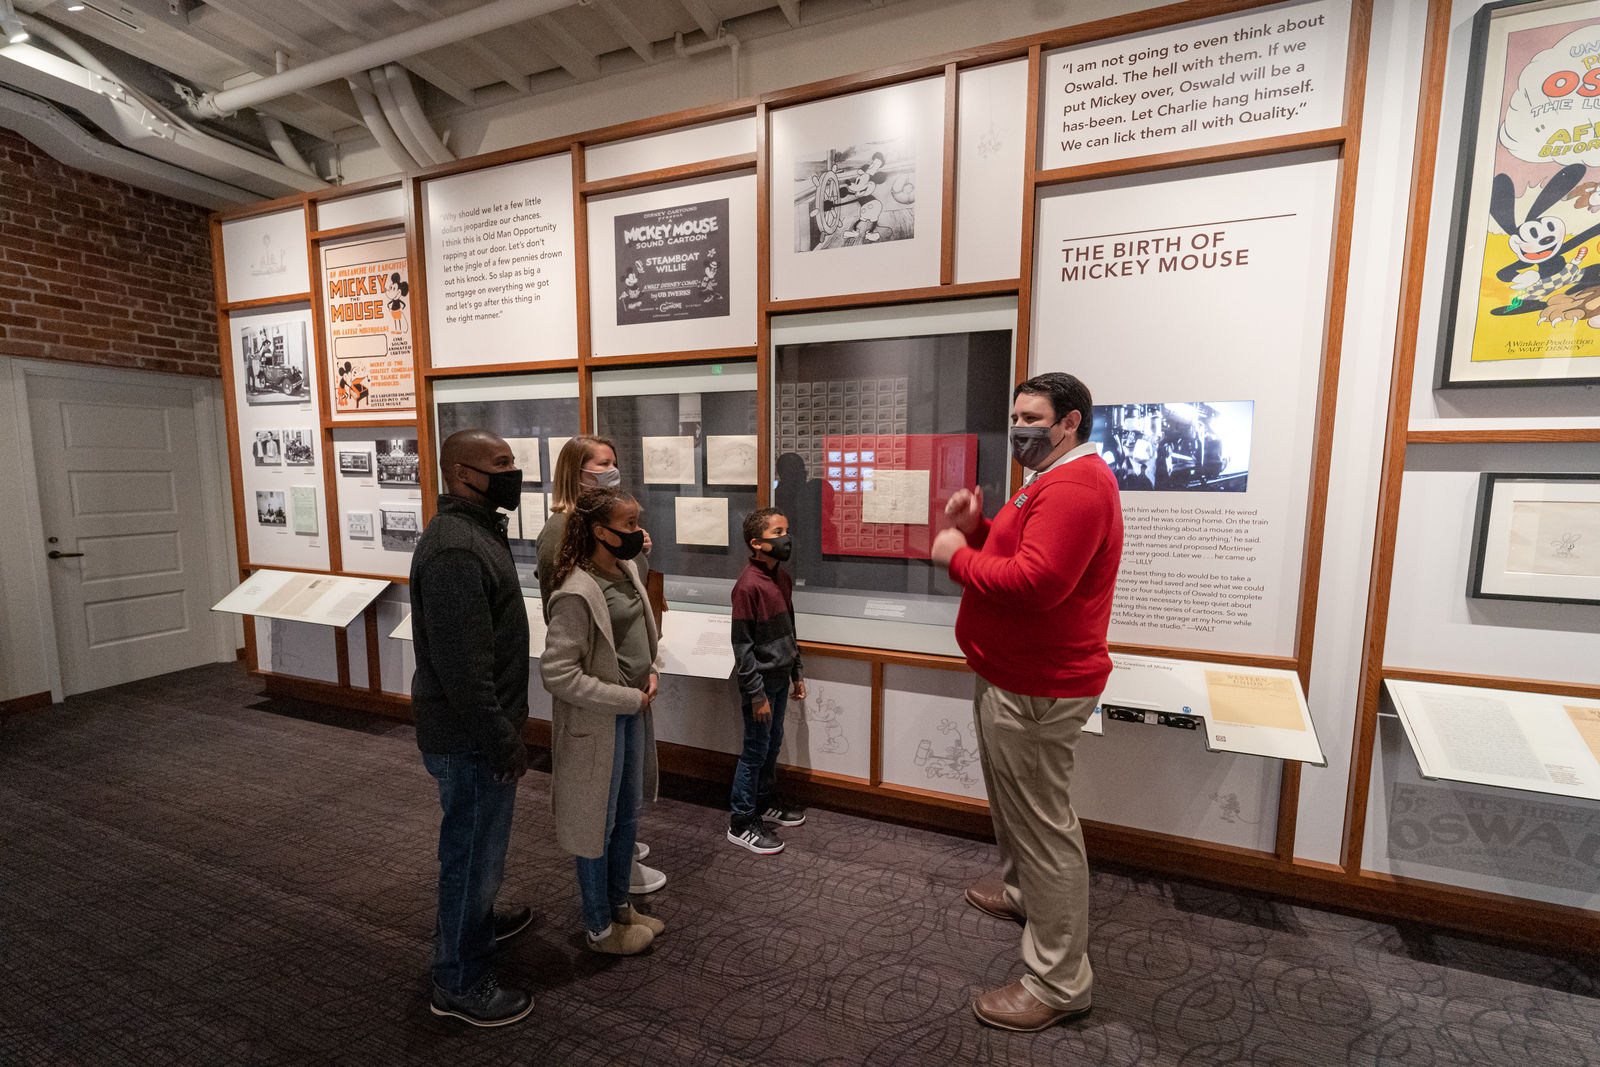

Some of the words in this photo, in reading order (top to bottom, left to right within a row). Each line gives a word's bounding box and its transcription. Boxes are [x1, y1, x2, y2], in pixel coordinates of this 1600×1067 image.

[1062, 63, 1072, 74] "I
[1076, 61, 1096, 72] am
[1101, 54, 1124, 68] not
[1128, 47, 1168, 65] going
[1173, 43, 1188, 53] to
[1193, 35, 1228, 49] even
[1233, 23, 1271, 42] think
[1276, 14, 1325, 33] about
[1064, 73, 1117, 94] Oswald.
[1122, 70, 1148, 83] The
[1152, 61, 1177, 78] hell
[1182, 55, 1213, 72] with
[1218, 50, 1262, 65] them.
[1268, 41, 1279, 56] If
[1283, 41, 1306, 53] we
[1063, 100, 1086, 116] put
[1090, 92, 1136, 109] Mickey
[1140, 86, 1174, 99] over,
[1179, 71, 1235, 92] Oswald
[1239, 65, 1265, 82] will
[1271, 64, 1290, 77] be
[1296, 63, 1304, 72] a
[1062, 115, 1126, 132] has-been.
[1131, 108, 1153, 121] Let
[1157, 99, 1207, 116] Charlie
[1212, 94, 1249, 108] hang
[1254, 78, 1314, 101] himself.
[1531, 99, 1573, 117] THE
[1060, 139, 1082, 151] We
[1086, 137, 1109, 148] can
[1114, 129, 1135, 143] lick
[1140, 126, 1176, 139] them
[1181, 119, 1197, 133] all
[1201, 113, 1233, 129] with
[1238, 101, 1306, 123] Quality."
[458, 207, 480, 218] should
[493, 204, 502, 212] let
[510, 200, 523, 209] few
[524, 196, 541, 206] little
[442, 225, 462, 234] dollars
[463, 218, 498, 232] jeopardize
[512, 212, 541, 222] chances.
[624, 224, 671, 244] MICKEY
[673, 216, 718, 236] MOUSE
[445, 237, 461, 247] think
[462, 235, 474, 244] this
[475, 234, 481, 242] is
[482, 231, 495, 240] Old
[496, 230, 511, 238] Man
[512, 222, 556, 237] Opportunity
[636, 240, 664, 249] SOUND
[668, 234, 707, 244] CARTOON
[442, 251, 467, 261] rapping
[489, 245, 507, 253] door.
[508, 241, 524, 250] Let's
[525, 238, 544, 248] don't
[1061, 244, 1104, 262] THE
[1113, 236, 1181, 258] BIRTH
[1191, 231, 1225, 250] OF
[453, 263, 463, 271] the
[465, 260, 482, 272] jingle
[483, 258, 491, 267] of
[497, 256, 510, 265] few
[511, 253, 538, 265] pennies
[539, 250, 562, 259] drown
[646, 252, 699, 266] STEAMBOAT
[656, 263, 686, 273] WILLIE
[1061, 258, 1150, 282] MICKEY
[1158, 249, 1249, 273] MOUSE
[330, 274, 388, 298] MICKEY
[456, 276, 465, 284] his
[466, 273, 487, 282] knock.
[488, 271, 497, 280] So
[498, 270, 512, 279] slap
[523, 267, 535, 277] big
[445, 289, 476, 298] mortgage
[487, 282, 523, 294] everything
[536, 279, 549, 289] got
[331, 300, 384, 322] MOUSE
[446, 302, 457, 311] and
[458, 301, 472, 309] let's
[473, 301, 482, 310] go
[483, 298, 499, 306] after
[501, 296, 513, 304] this
[514, 294, 532, 304] thing
[446, 315, 456, 323] the
[458, 313, 473, 324] right
[474, 310, 503, 320] manner."
[1546, 338, 1594, 346] Production
[1546, 344, 1584, 352] DISNEY
[1152, 524, 1180, 533] thinking
